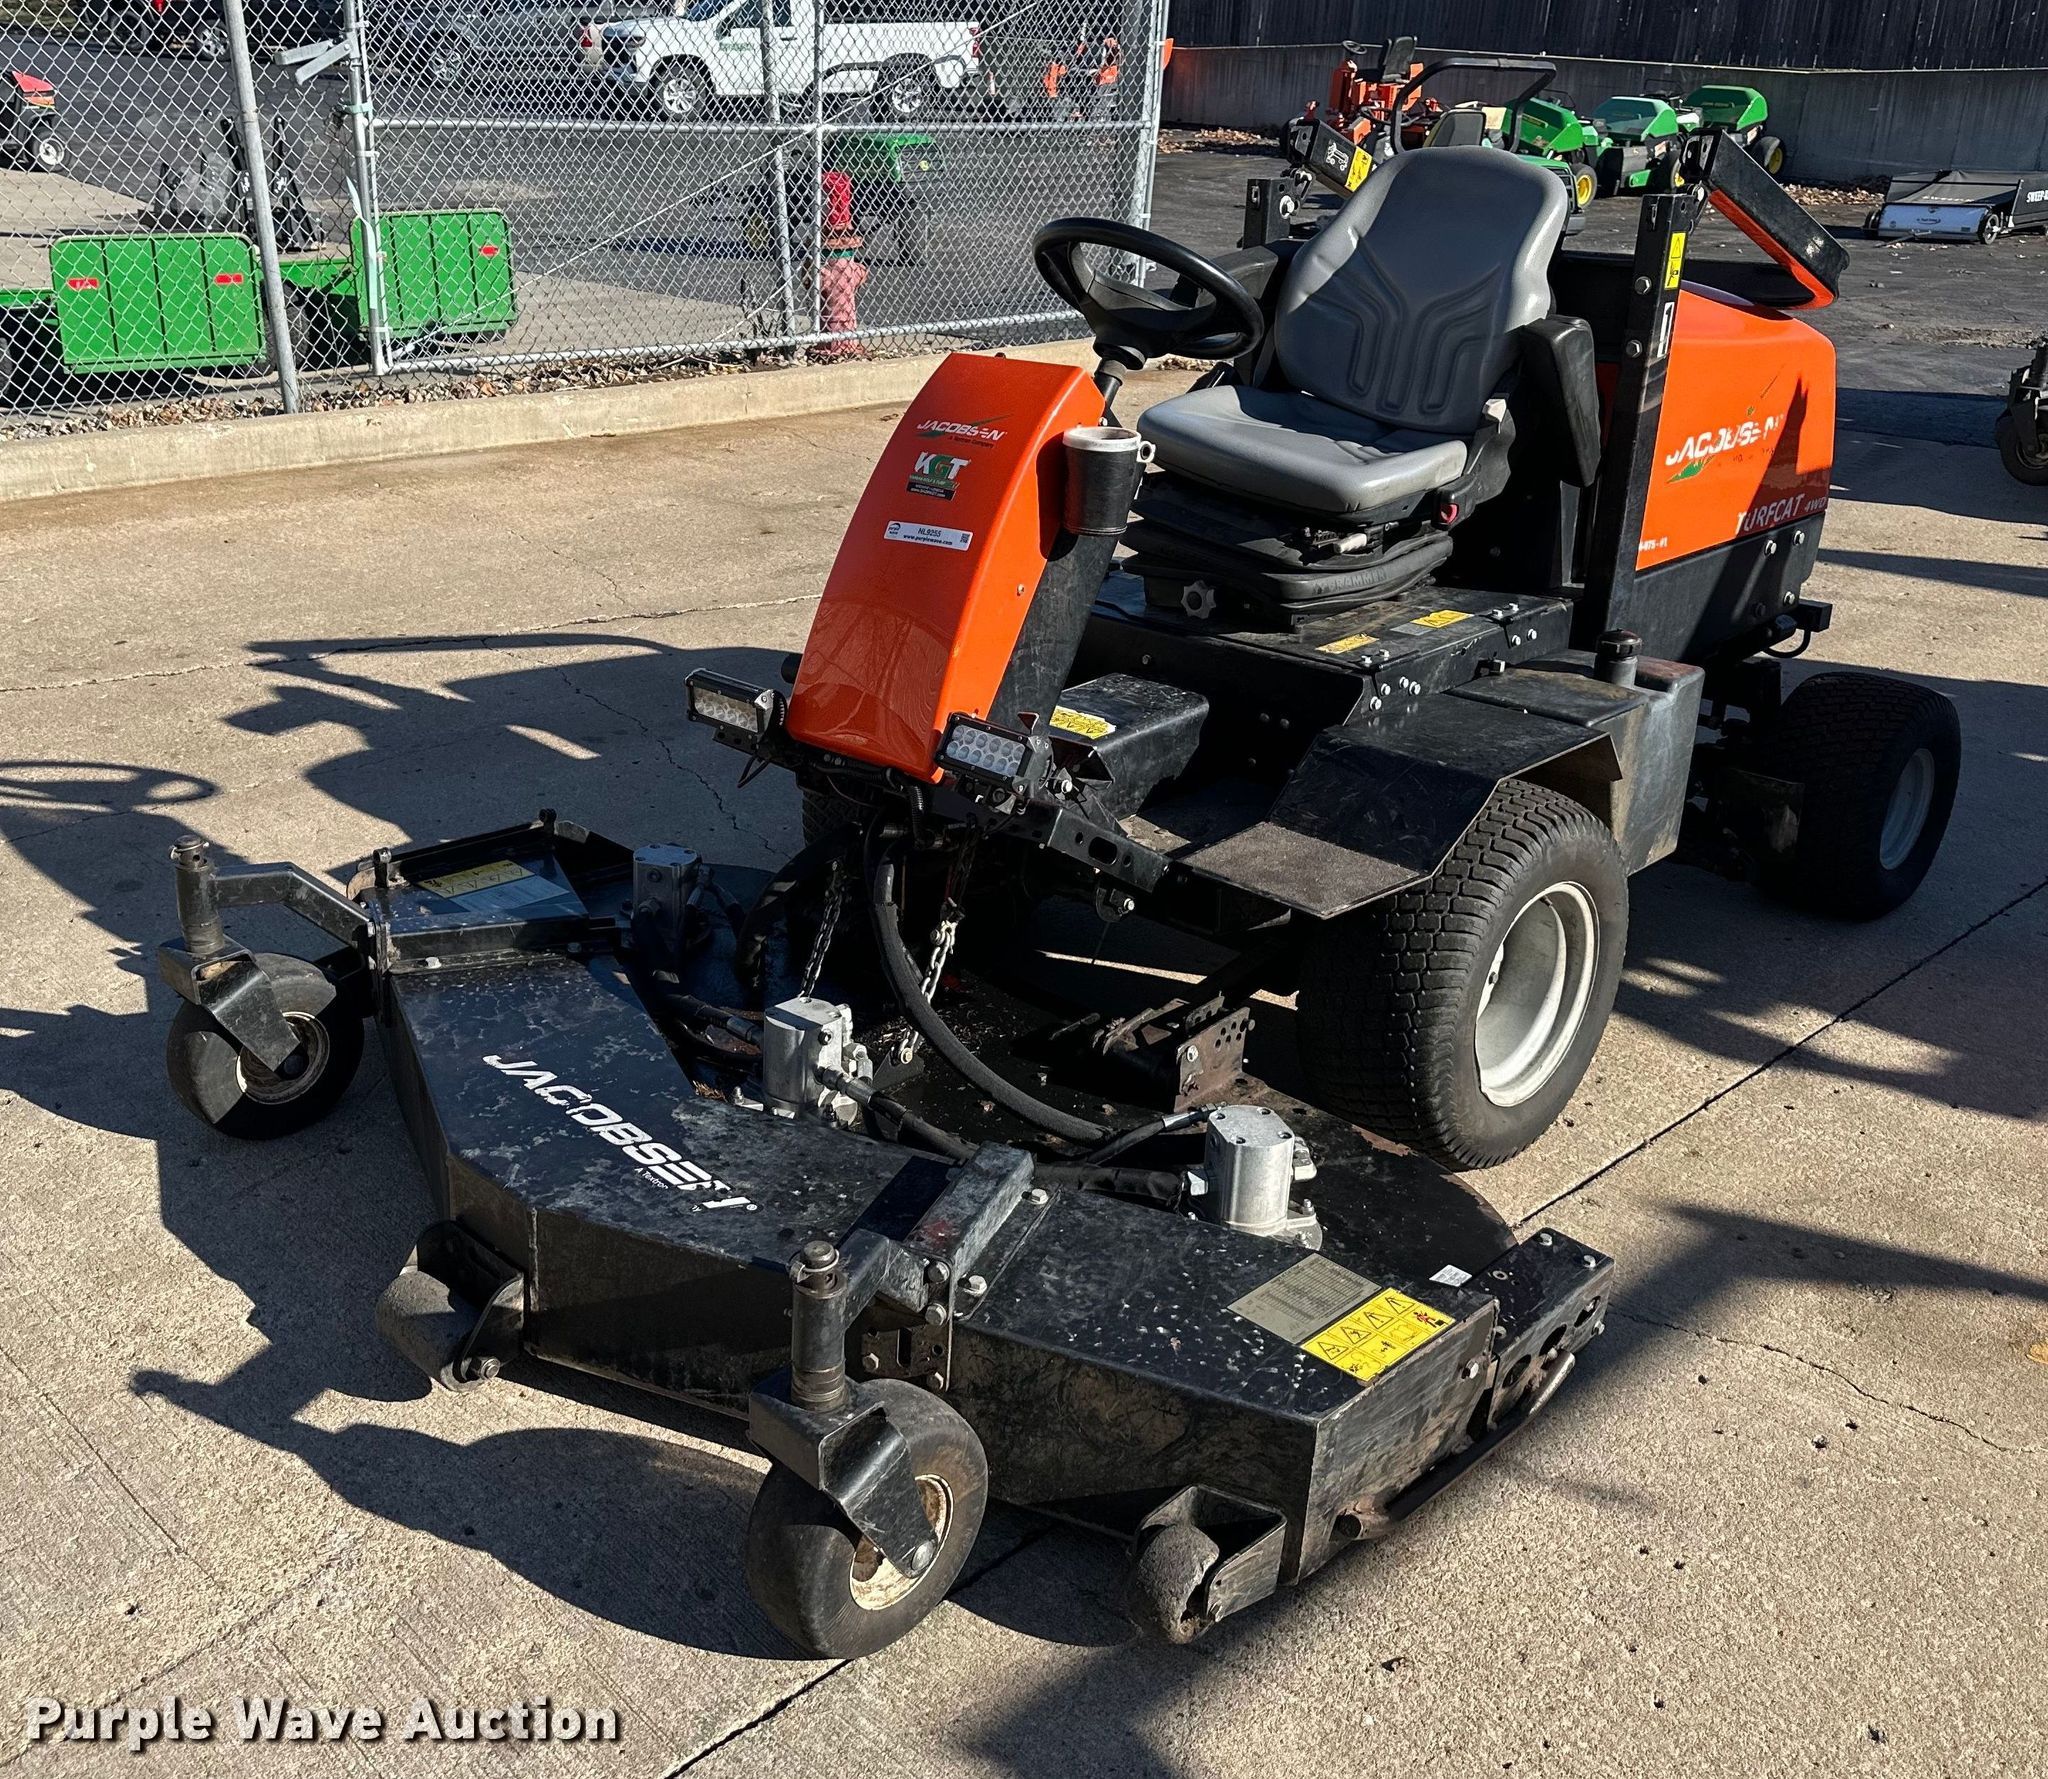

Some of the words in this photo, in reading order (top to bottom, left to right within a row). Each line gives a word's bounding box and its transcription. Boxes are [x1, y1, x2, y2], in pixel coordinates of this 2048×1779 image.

[917, 420, 1005, 440] JACOBSEN
[914, 451, 969, 480] KGT
[1735, 494, 1805, 534] TURFCAT
[1804, 497, 1827, 512] 4WD
[903, 534, 953, 546] www.purplewave.com
[642, 1170, 669, 1190] Textron
